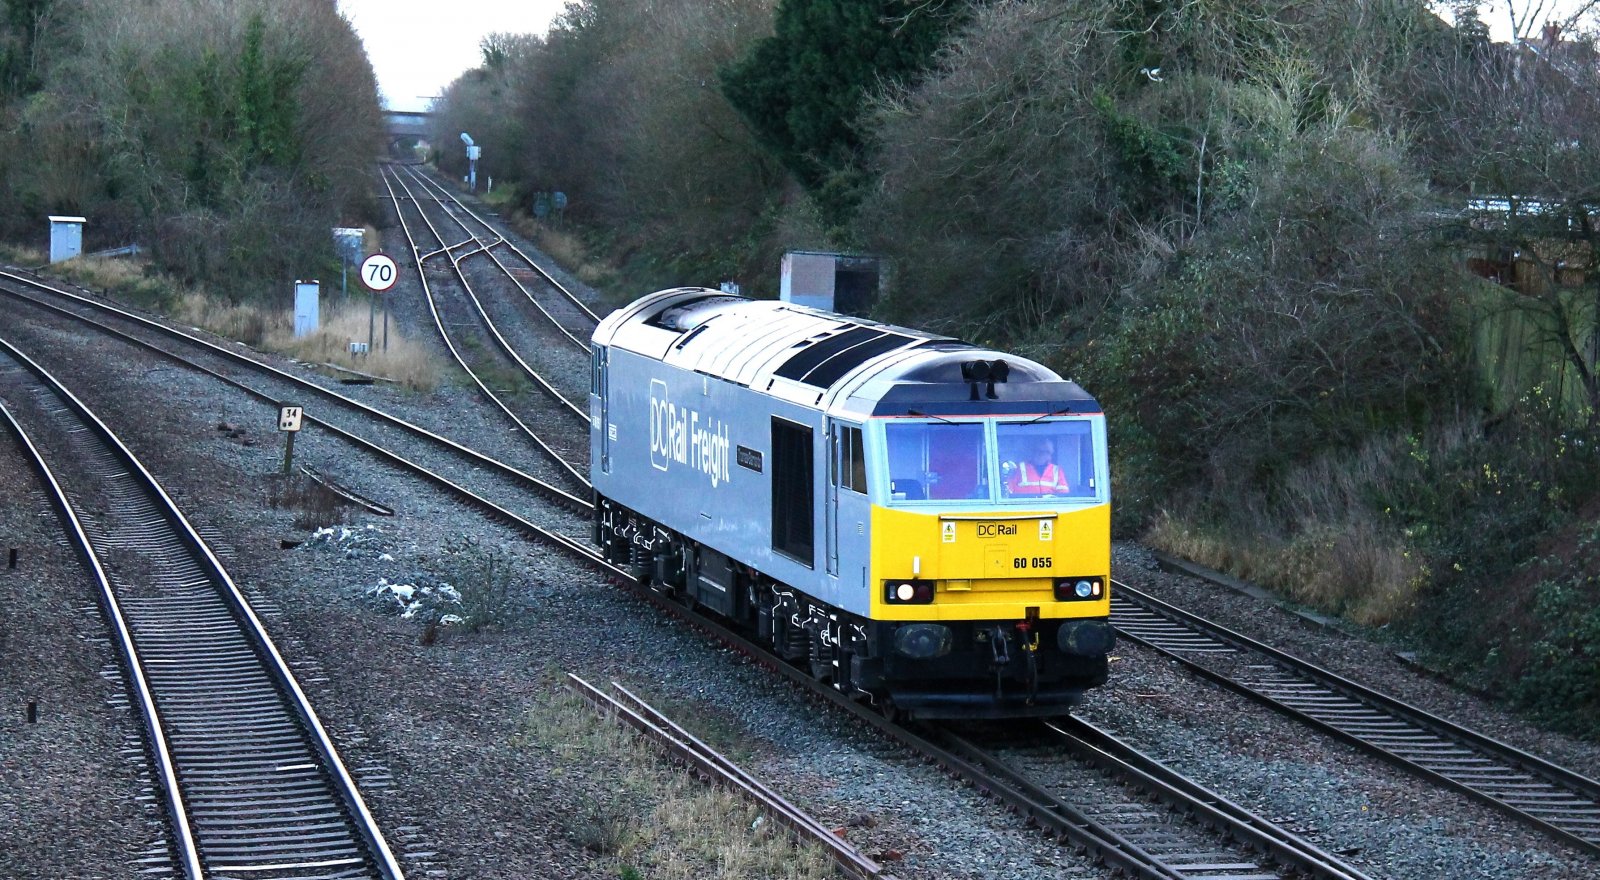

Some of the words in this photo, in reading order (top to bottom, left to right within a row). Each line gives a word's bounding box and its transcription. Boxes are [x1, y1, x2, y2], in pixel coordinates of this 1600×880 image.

[368, 264, 392, 282] 70
[286, 408, 297, 419] 34
[651, 397, 667, 457] DC
[669, 403, 687, 465] Rail
[691, 410, 730, 488] Freight
[978, 524, 995, 536] DC
[997, 524, 1017, 535] Rail
[1013, 557, 1027, 569] 60
[1031, 557, 1052, 569] 055
